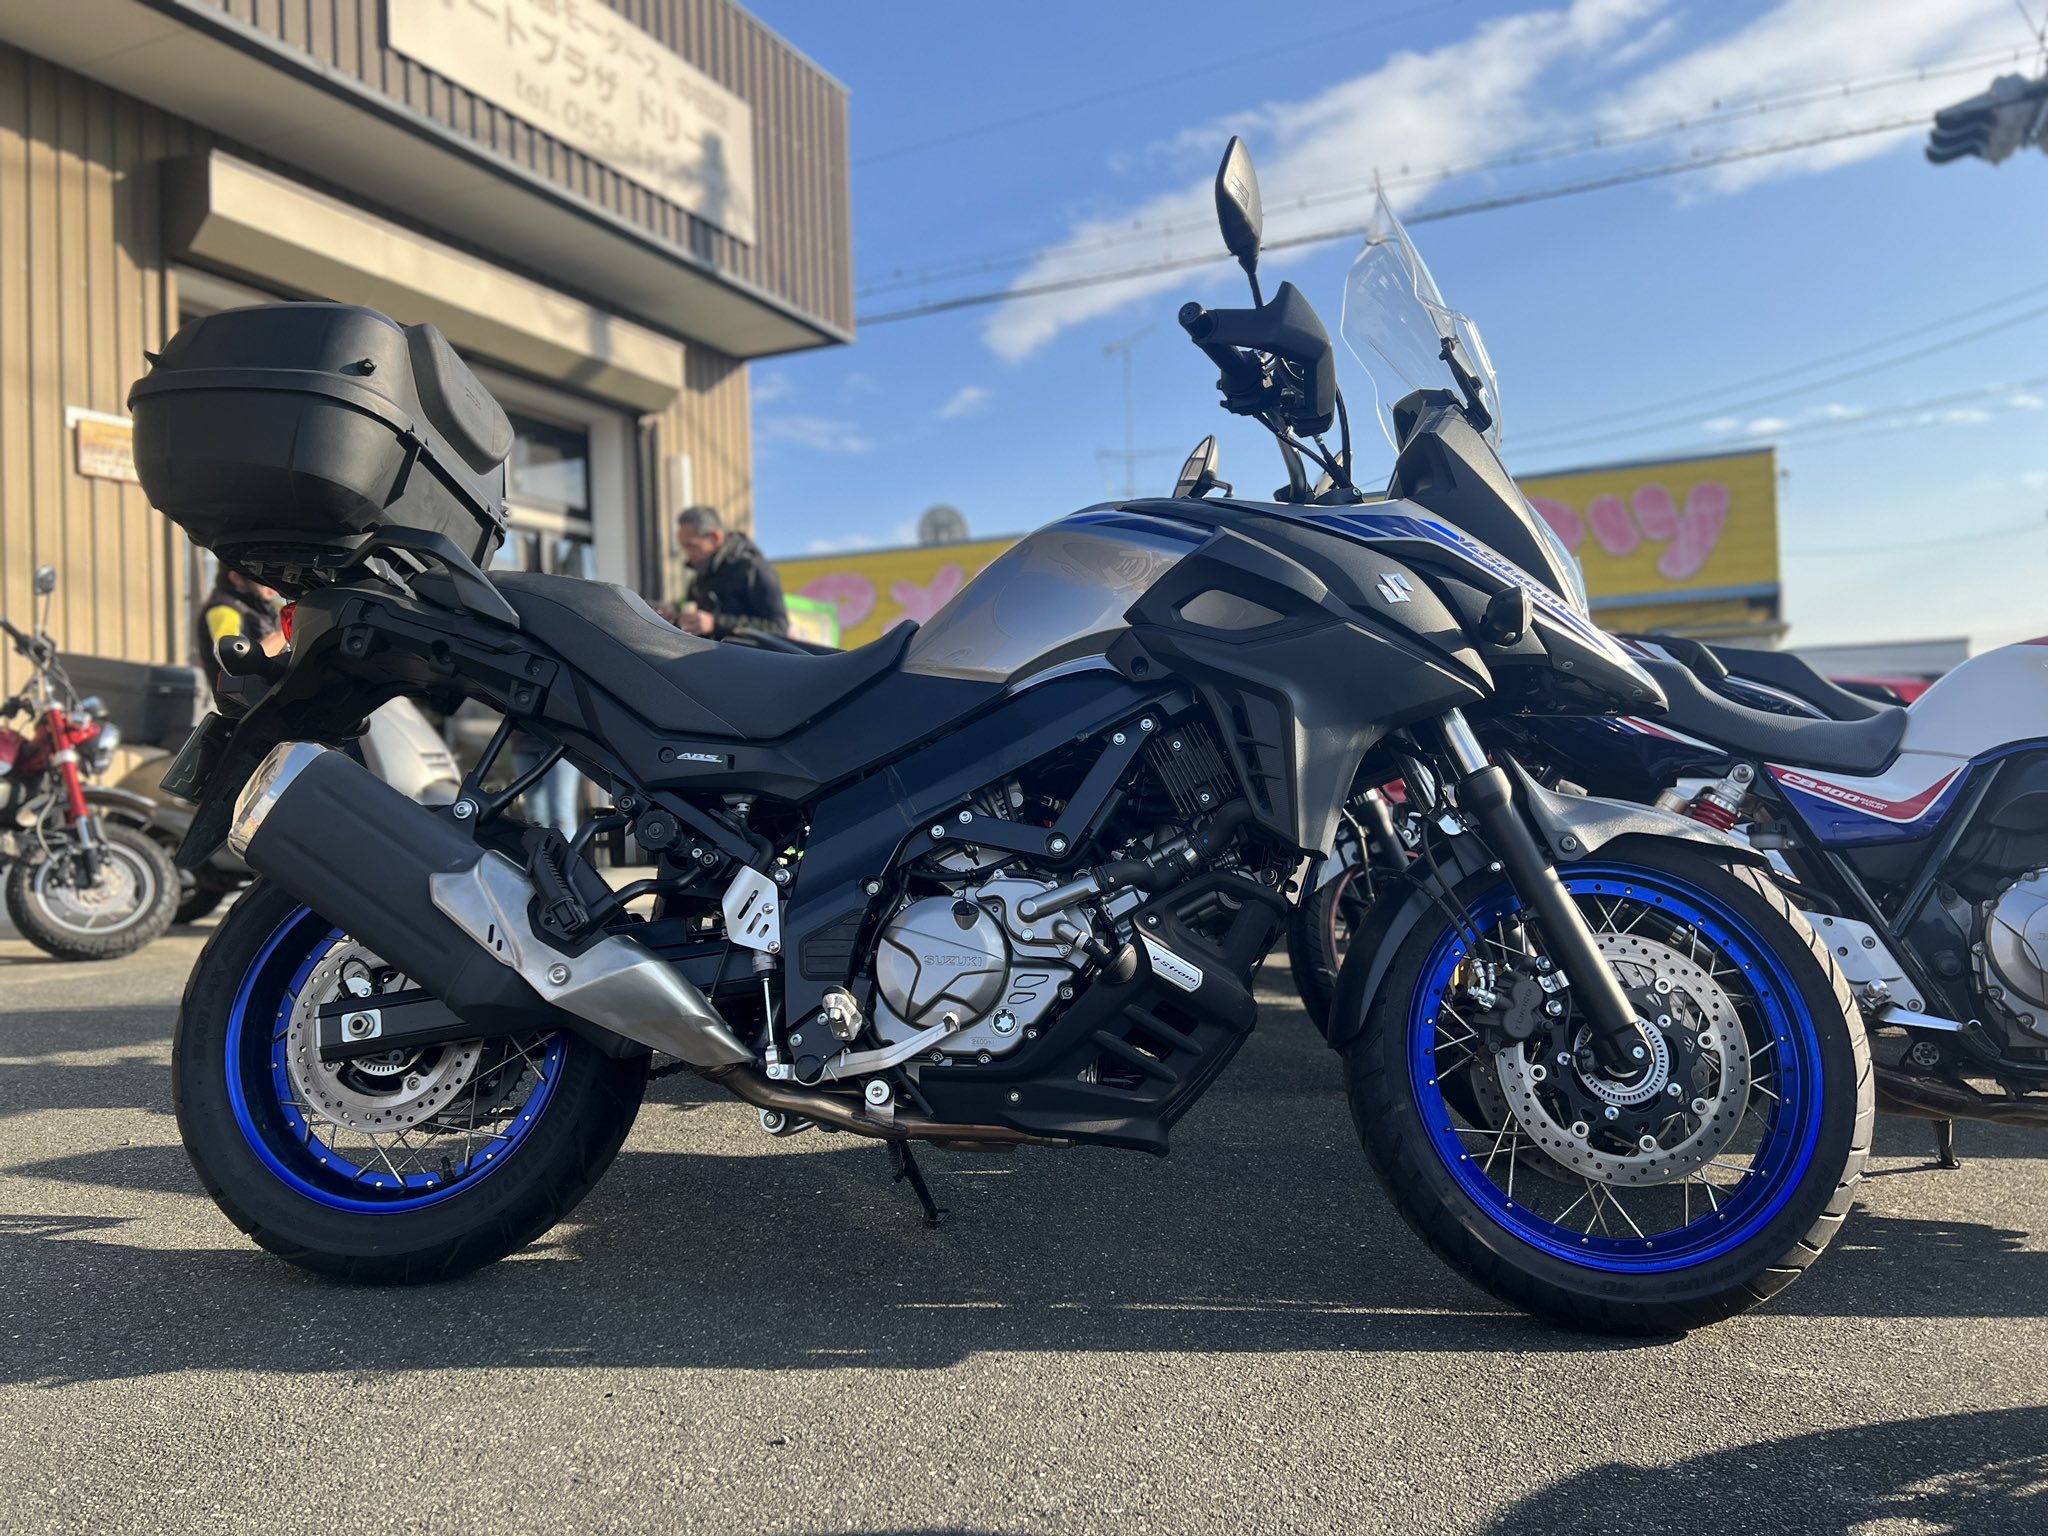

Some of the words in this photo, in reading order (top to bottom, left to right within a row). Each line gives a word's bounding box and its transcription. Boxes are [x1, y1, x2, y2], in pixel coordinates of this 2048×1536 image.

[440, 0, 618, 104] ートプラザ
[677, 752, 720, 762] ABS
[1782, 773, 1860, 802] CB400
[923, 954, 982, 967] SUZUKI
